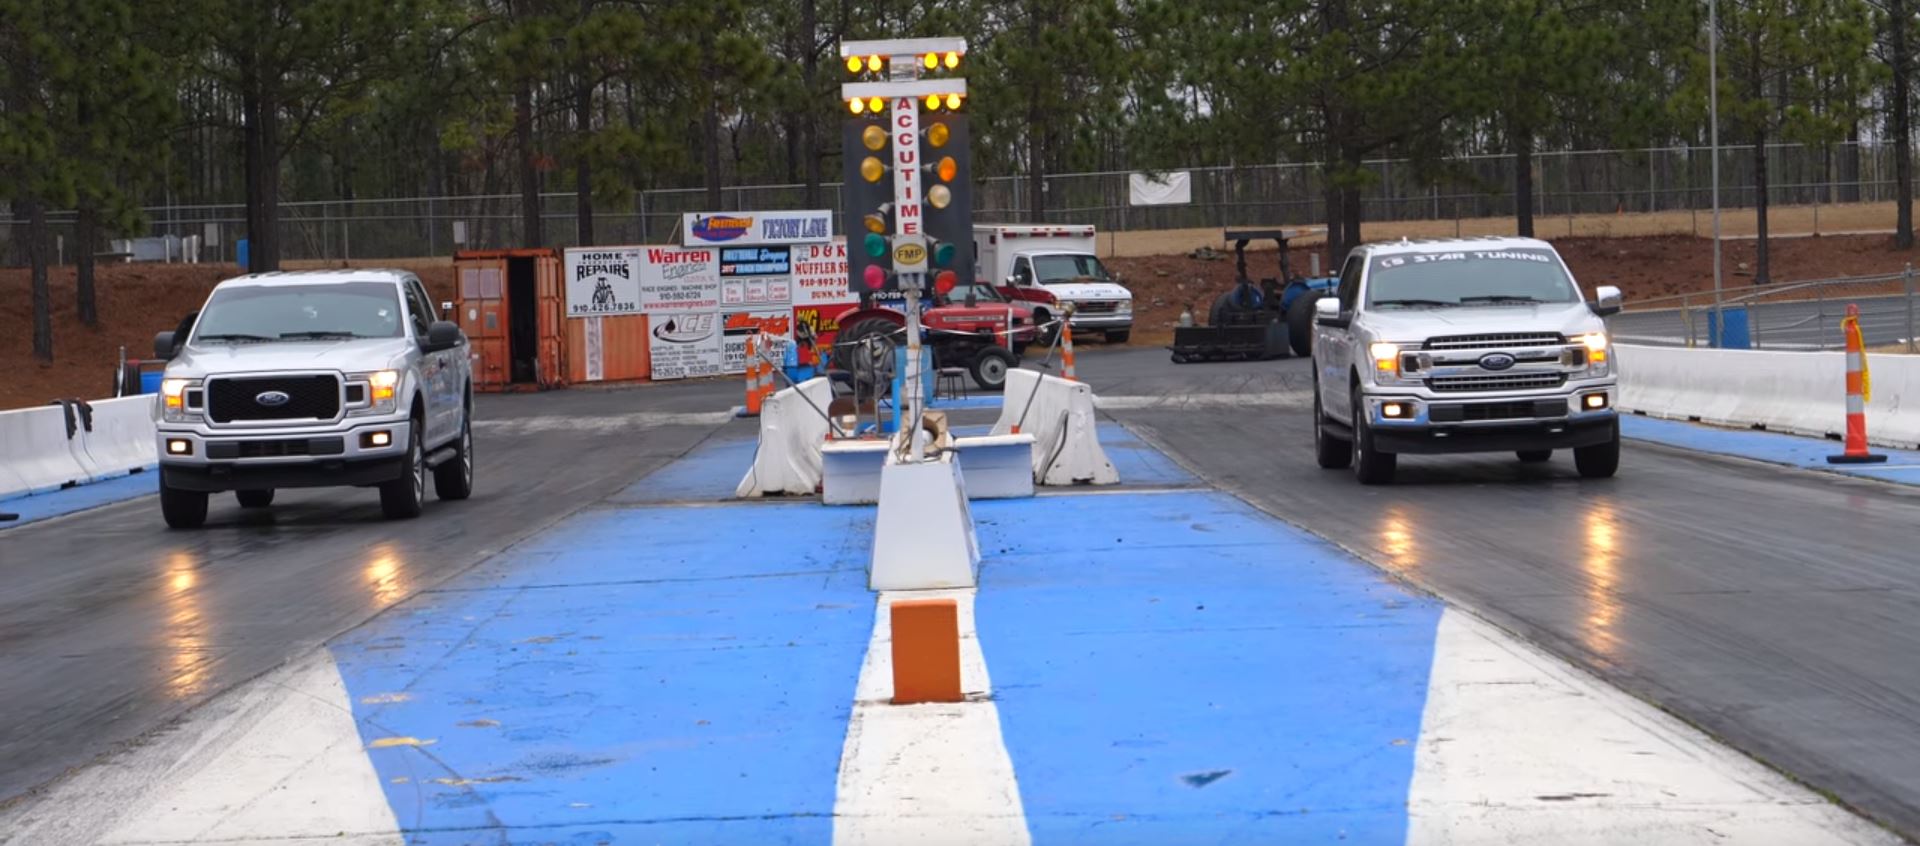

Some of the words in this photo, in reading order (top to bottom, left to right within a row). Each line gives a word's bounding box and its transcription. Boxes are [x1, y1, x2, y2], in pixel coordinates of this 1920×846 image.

[897, 97, 919, 235] ACCUTIME
[763, 218, 800, 239] VICTORY
[801, 218, 828, 238] LANE
[582, 252, 622, 260] HOME
[648, 248, 711, 264] Warren
[810, 245, 819, 258] D
[823, 244, 832, 257] &
[837, 245, 846, 257] K
[898, 248, 922, 260] FMP
[1414, 251, 1465, 263] STAR
[1473, 251, 1549, 263] TUNING
[576, 263, 629, 281] REPAIRS
[794, 261, 836, 275] MUFFLER
